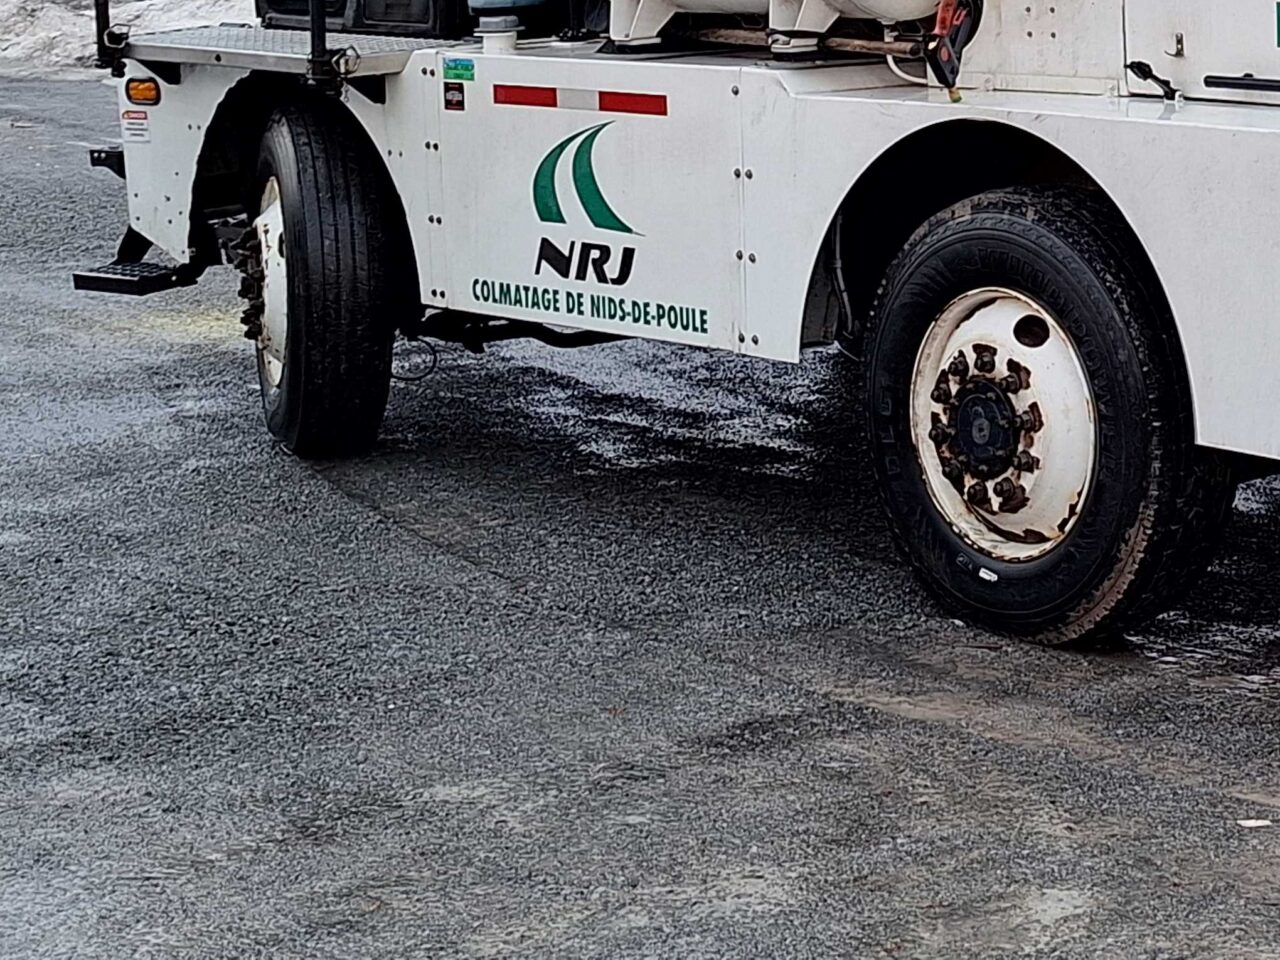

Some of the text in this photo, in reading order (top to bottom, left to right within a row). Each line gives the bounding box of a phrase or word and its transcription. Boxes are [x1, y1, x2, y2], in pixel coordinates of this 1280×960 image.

[535, 236, 636, 286] NRJ
[472, 277, 708, 334] COLMATAGE DE NIDS-DE-POULE
